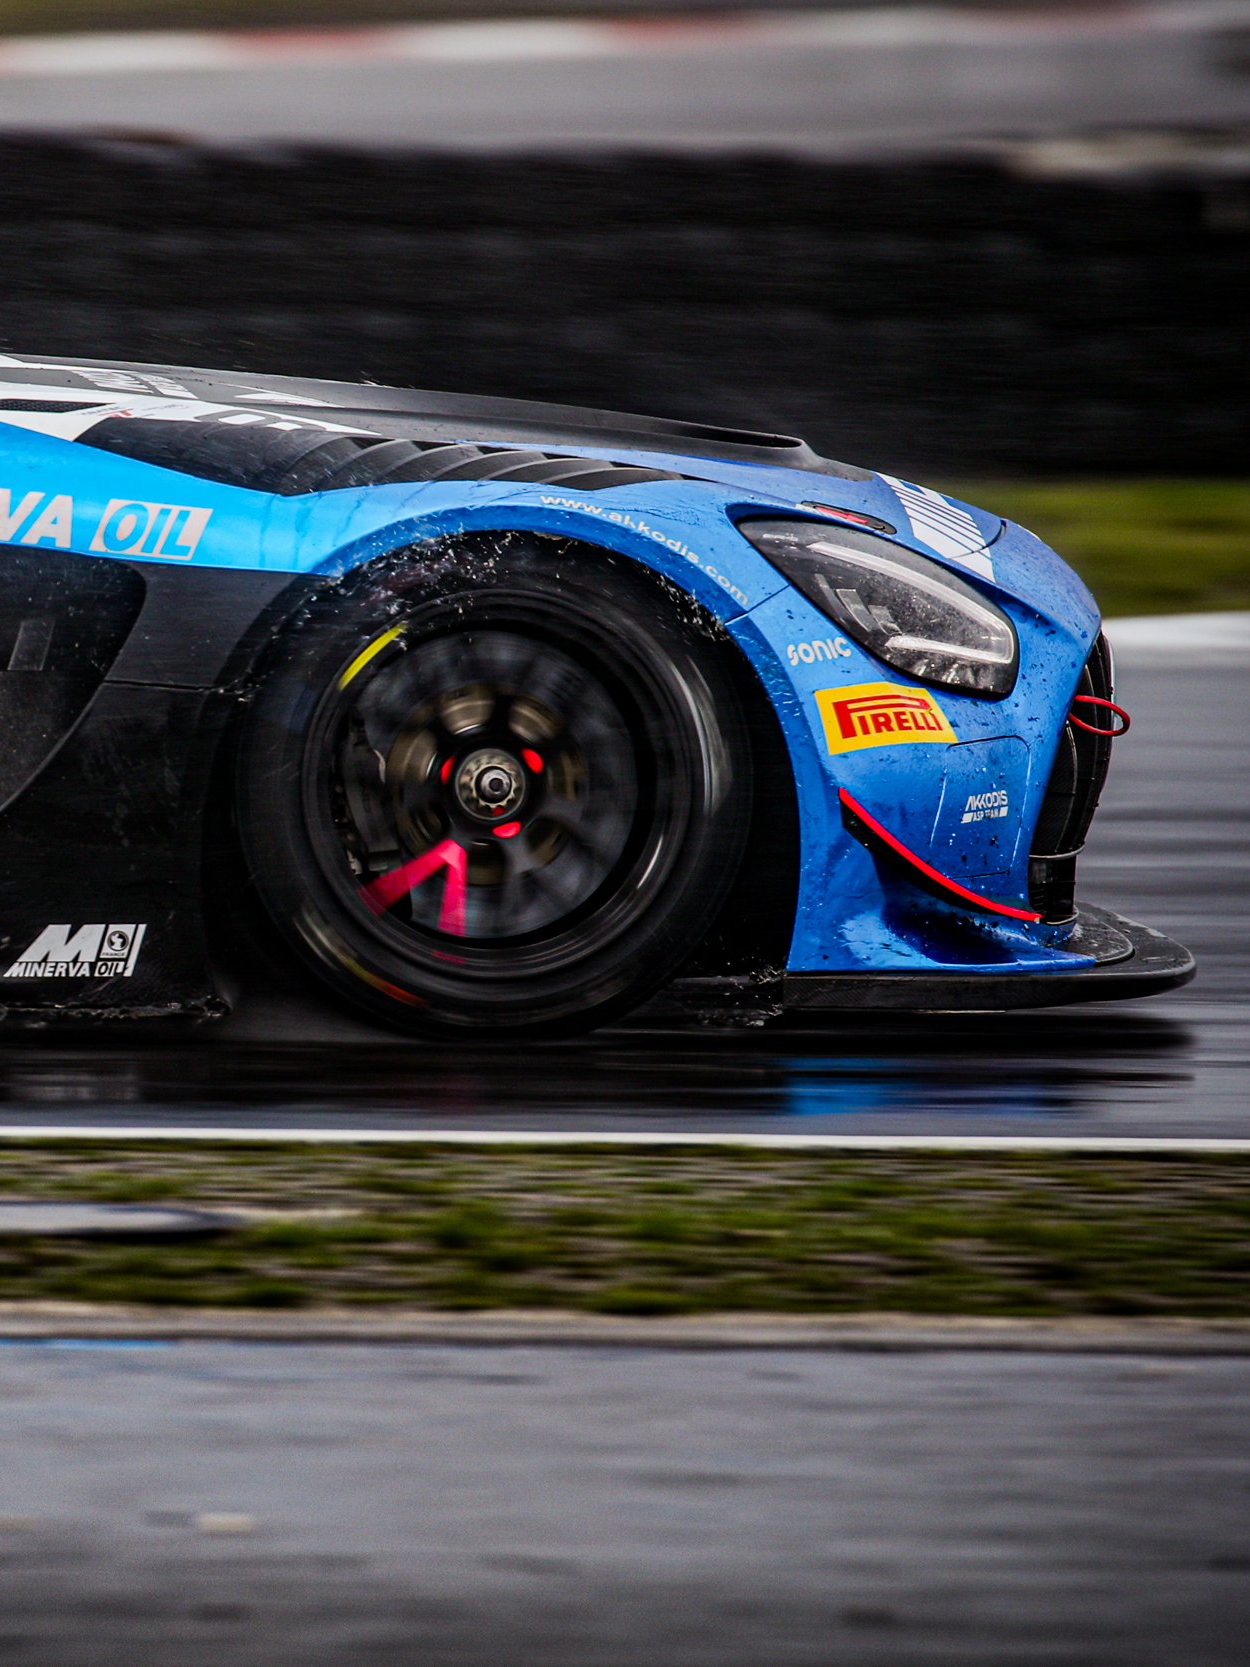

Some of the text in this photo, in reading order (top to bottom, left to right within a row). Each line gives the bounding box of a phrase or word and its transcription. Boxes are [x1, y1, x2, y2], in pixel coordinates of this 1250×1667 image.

[102, 502, 192, 557] OIL
[539, 495, 749, 606] www.akkodis.com
[832, 693, 944, 740] PIRELLI
[3, 961, 124, 977] MINERVA OIL
